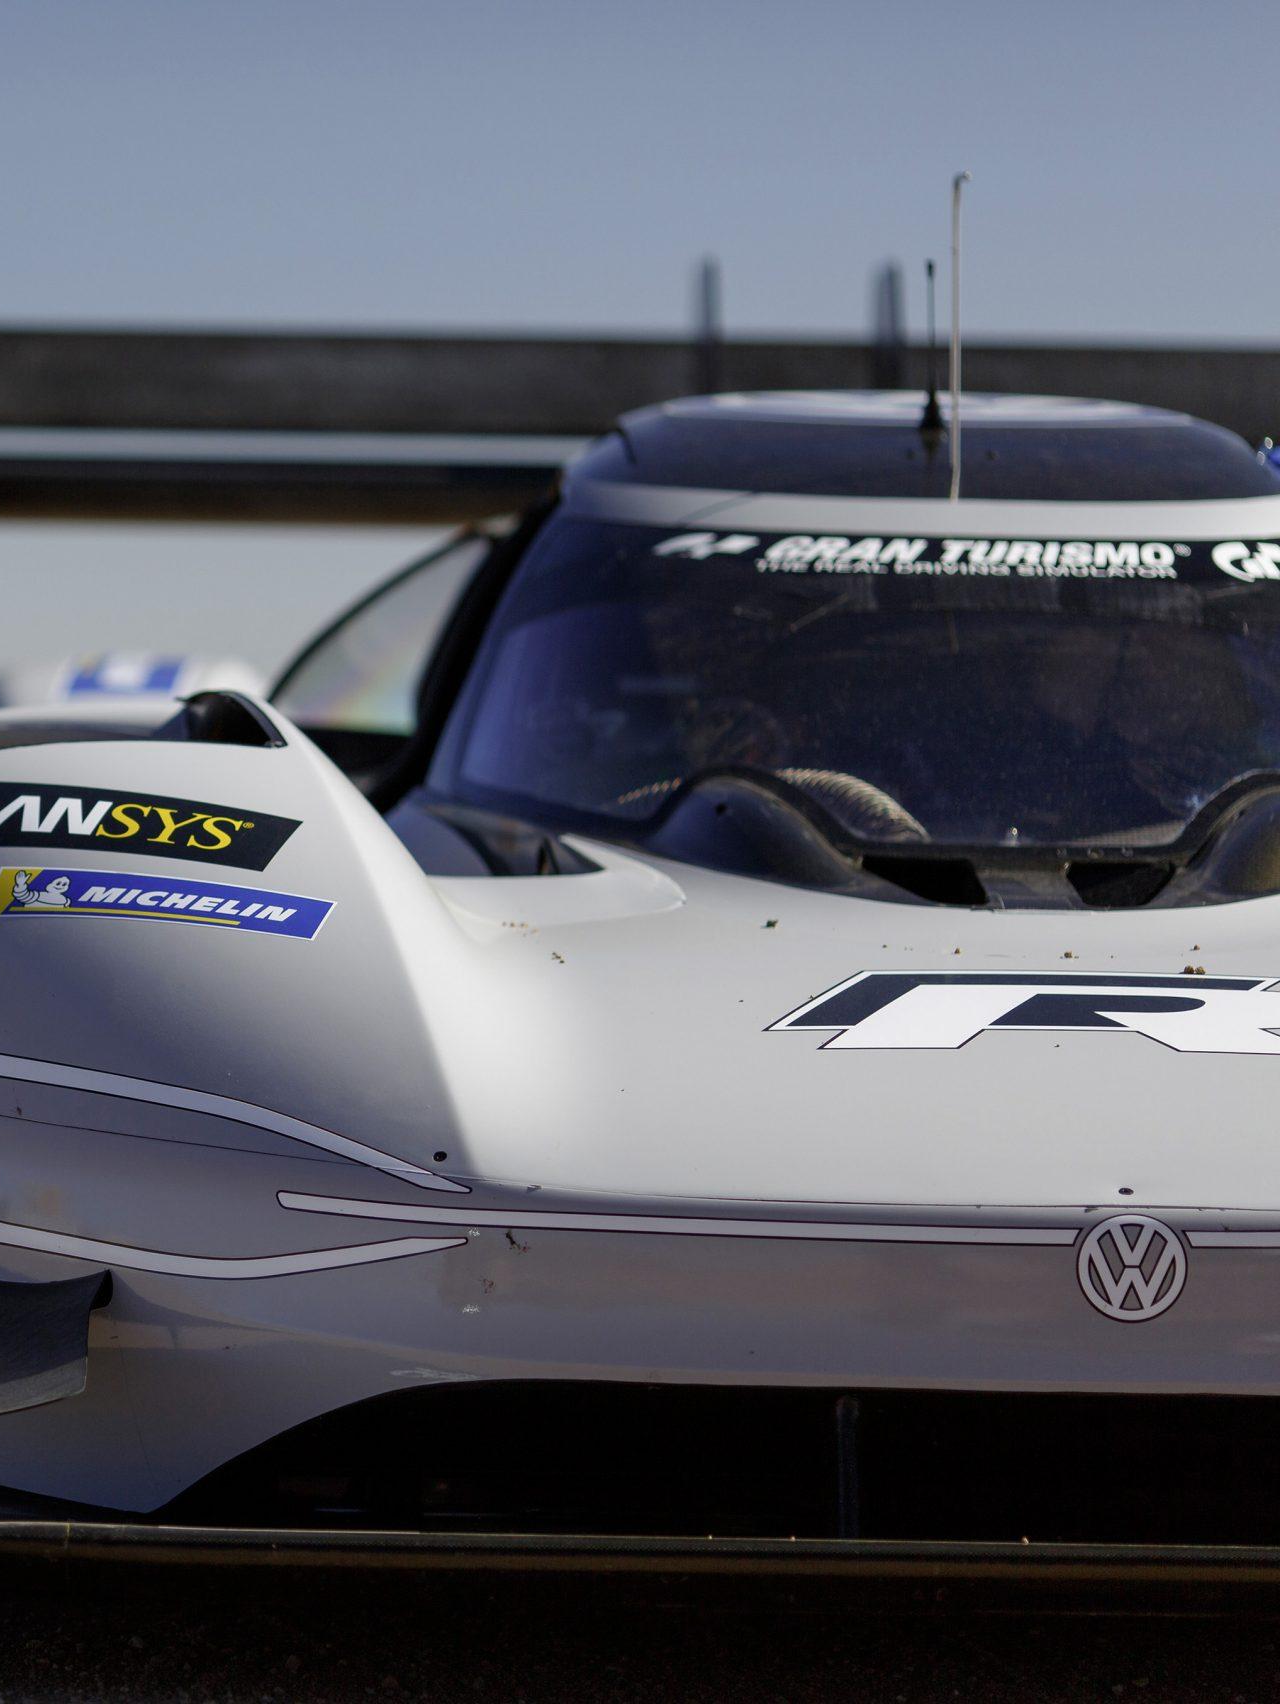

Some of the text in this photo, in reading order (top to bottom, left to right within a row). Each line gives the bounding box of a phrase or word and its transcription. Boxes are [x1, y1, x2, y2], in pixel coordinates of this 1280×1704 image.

[765, 535, 927, 564] GRAN
[813, 558, 889, 575] REAL
[894, 560, 1010, 577] DRIVING
[1016, 563, 1178, 579] SIMULATOR
[78, 886, 297, 922] MICHELIN
